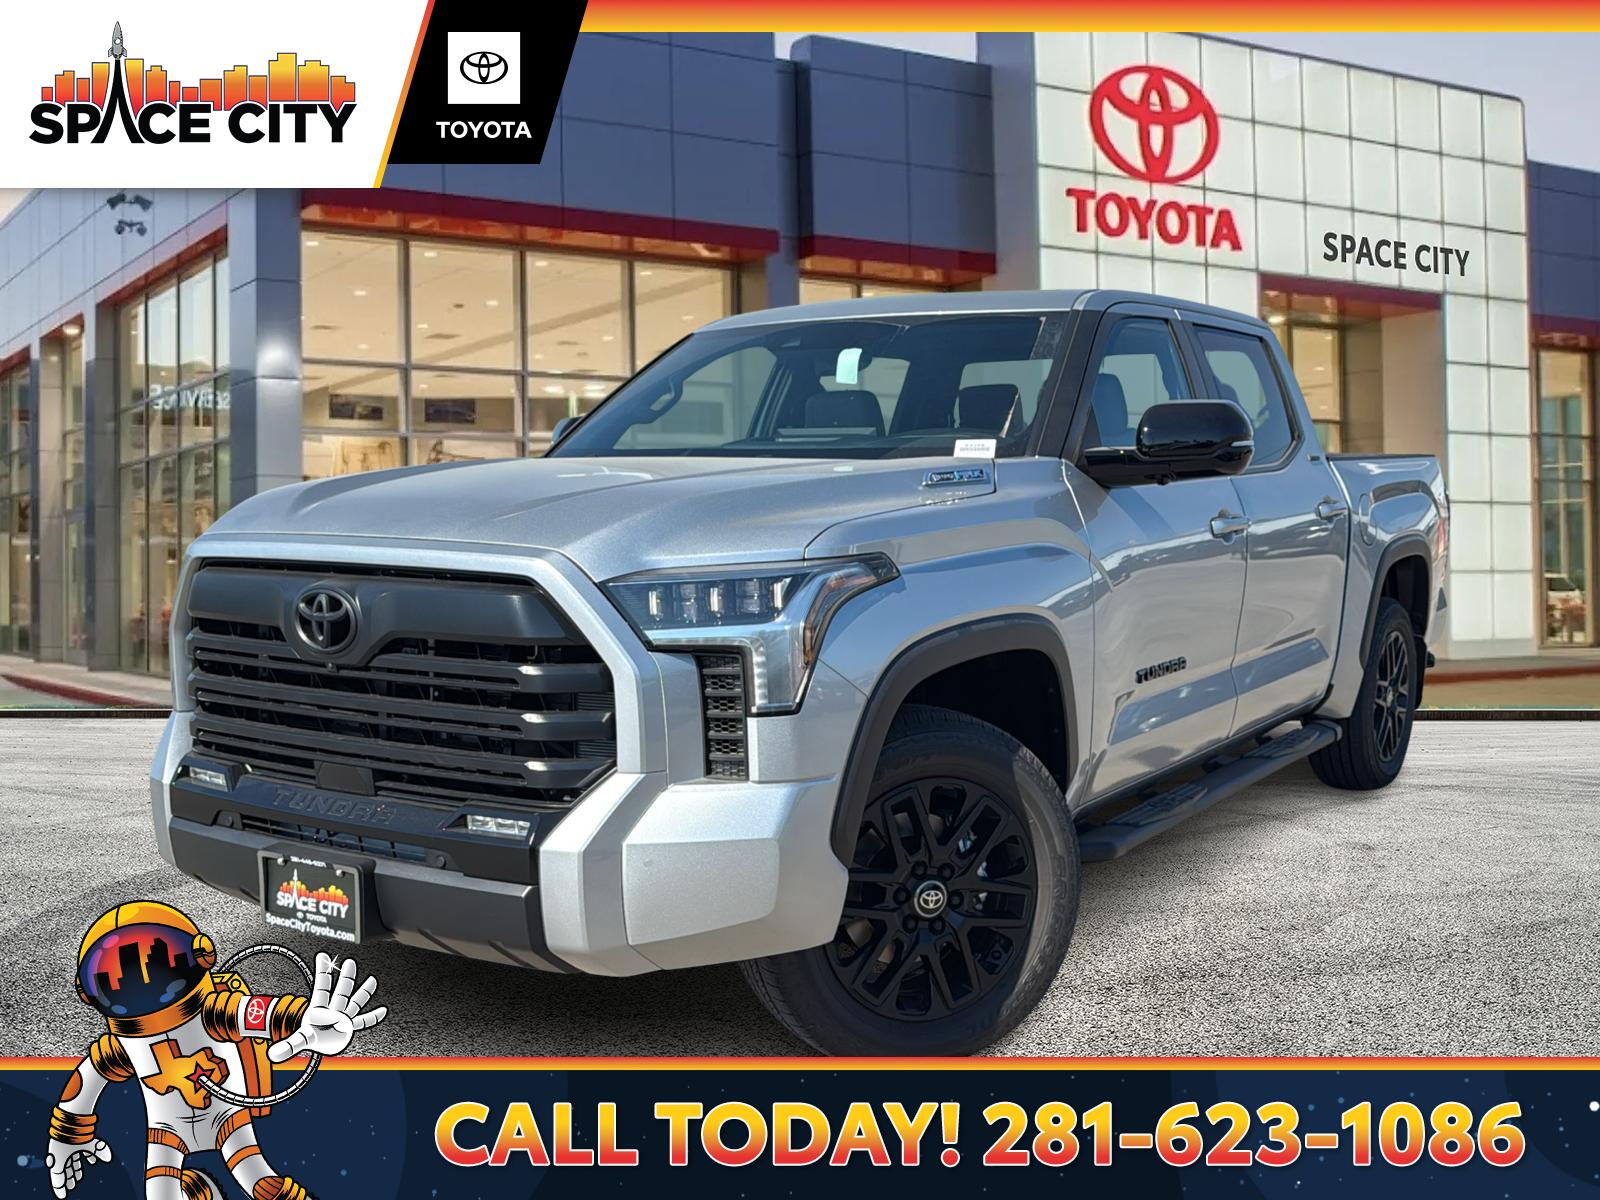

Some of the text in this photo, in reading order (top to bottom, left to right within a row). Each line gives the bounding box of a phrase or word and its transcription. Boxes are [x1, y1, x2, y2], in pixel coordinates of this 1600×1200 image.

[1066, 187, 1243, 252] TOYOTA
[1323, 231, 1470, 277] SPACE CITY
[1135, 656, 1187, 684] TUNDRA
[272, 785, 398, 825] TUNDRA
[276, 890, 349, 919] SPACE CITY
[306, 913, 328, 923] TOYOTA
[265, 912, 355, 942] SpaceCityToyota.com
